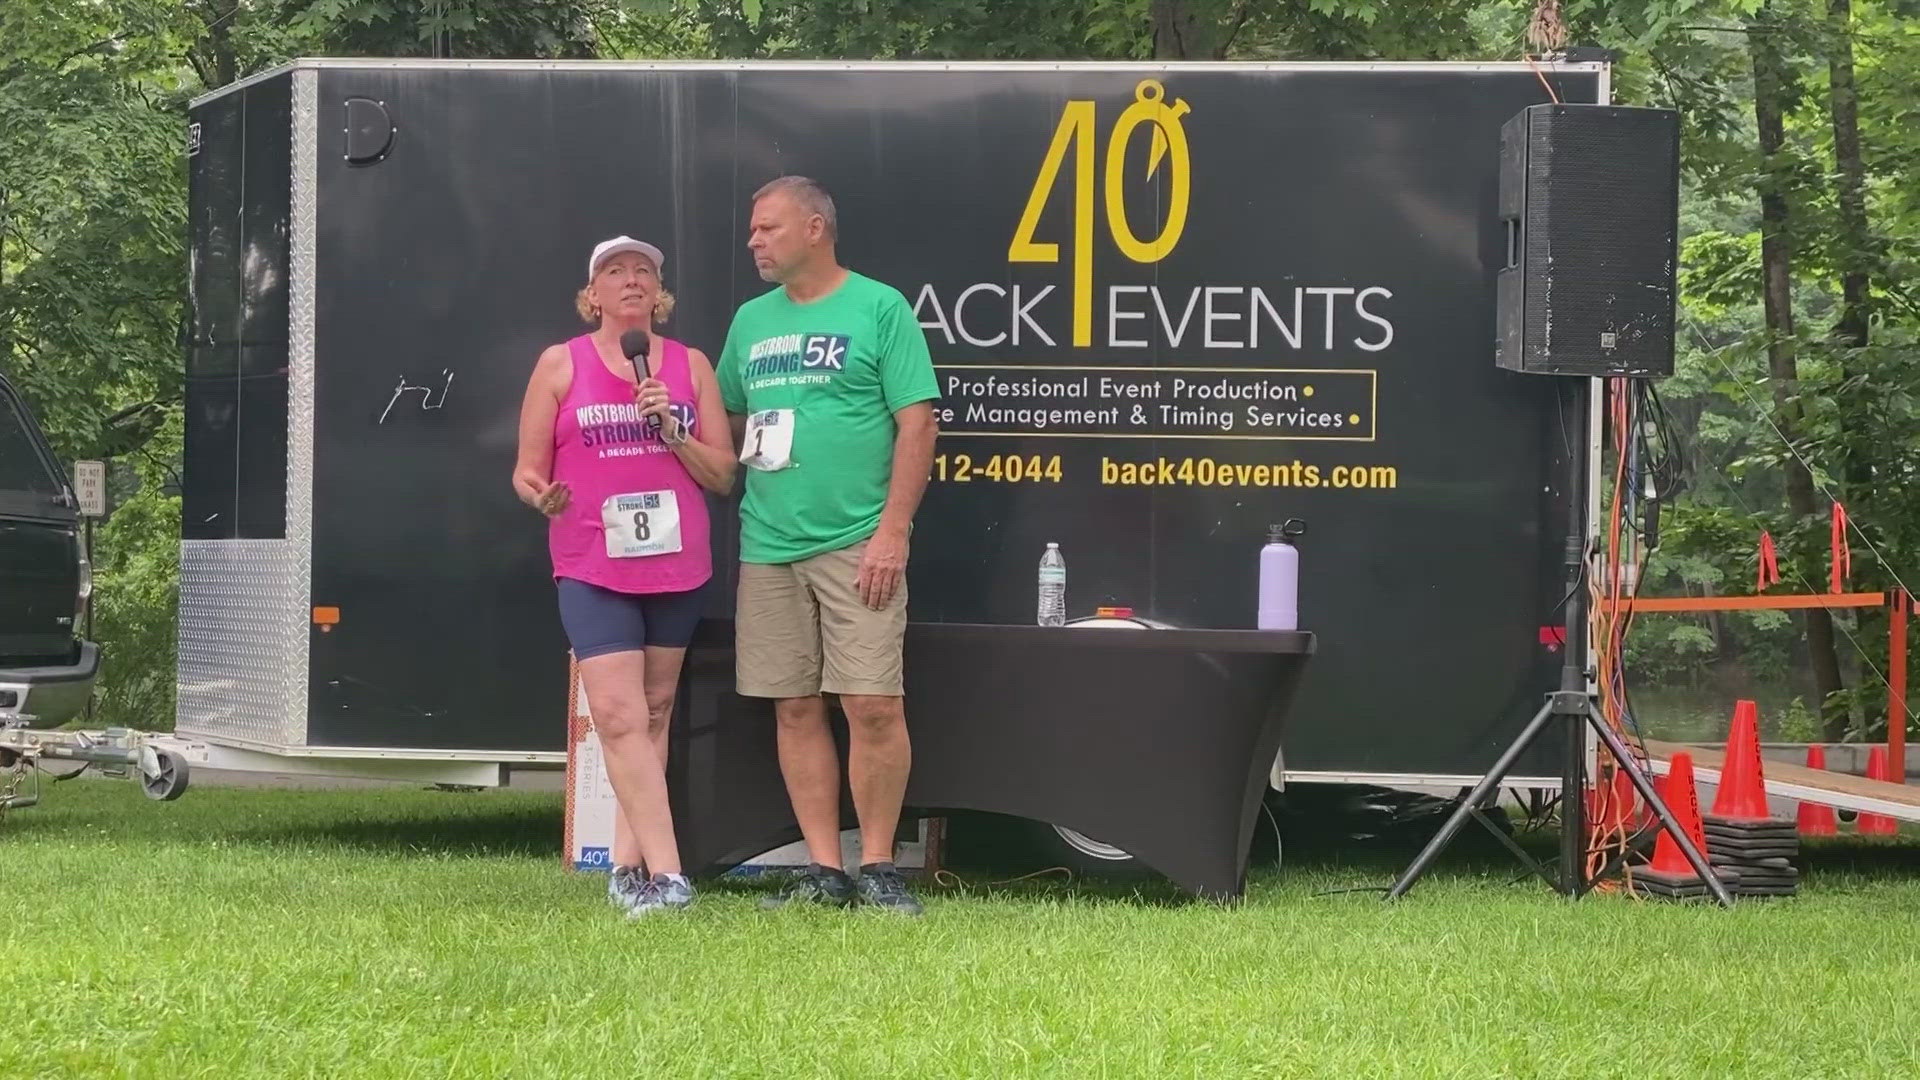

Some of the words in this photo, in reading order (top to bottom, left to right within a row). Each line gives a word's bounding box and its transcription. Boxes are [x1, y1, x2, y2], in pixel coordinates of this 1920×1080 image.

[1008, 80, 1191, 347] 40
[912, 283, 1057, 347] ACK
[1108, 284, 1395, 351] EVENTS
[745, 353, 800, 380] STRONG
[755, 377, 786, 389] DECADE
[788, 375, 832, 386] TOGETHER
[948, 375, 1088, 398] Professional
[1100, 377, 1162, 398] Event
[1173, 379, 1297, 401] Production
[576, 403, 646, 428] WESTBROO
[932, 407, 955, 423] ce
[965, 402, 1119, 428] Management
[1129, 403, 1148, 425] &
[1159, 405, 1234, 431] Timing
[1246, 405, 1343, 428] Services
[599, 449, 606, 459] A
[607, 446, 645, 458] DECADE
[754, 428, 763, 457] 1
[935, 454, 1063, 483] 12-4044
[1101, 456, 1397, 488] back40events.com
[633, 511, 651, 541] 8
